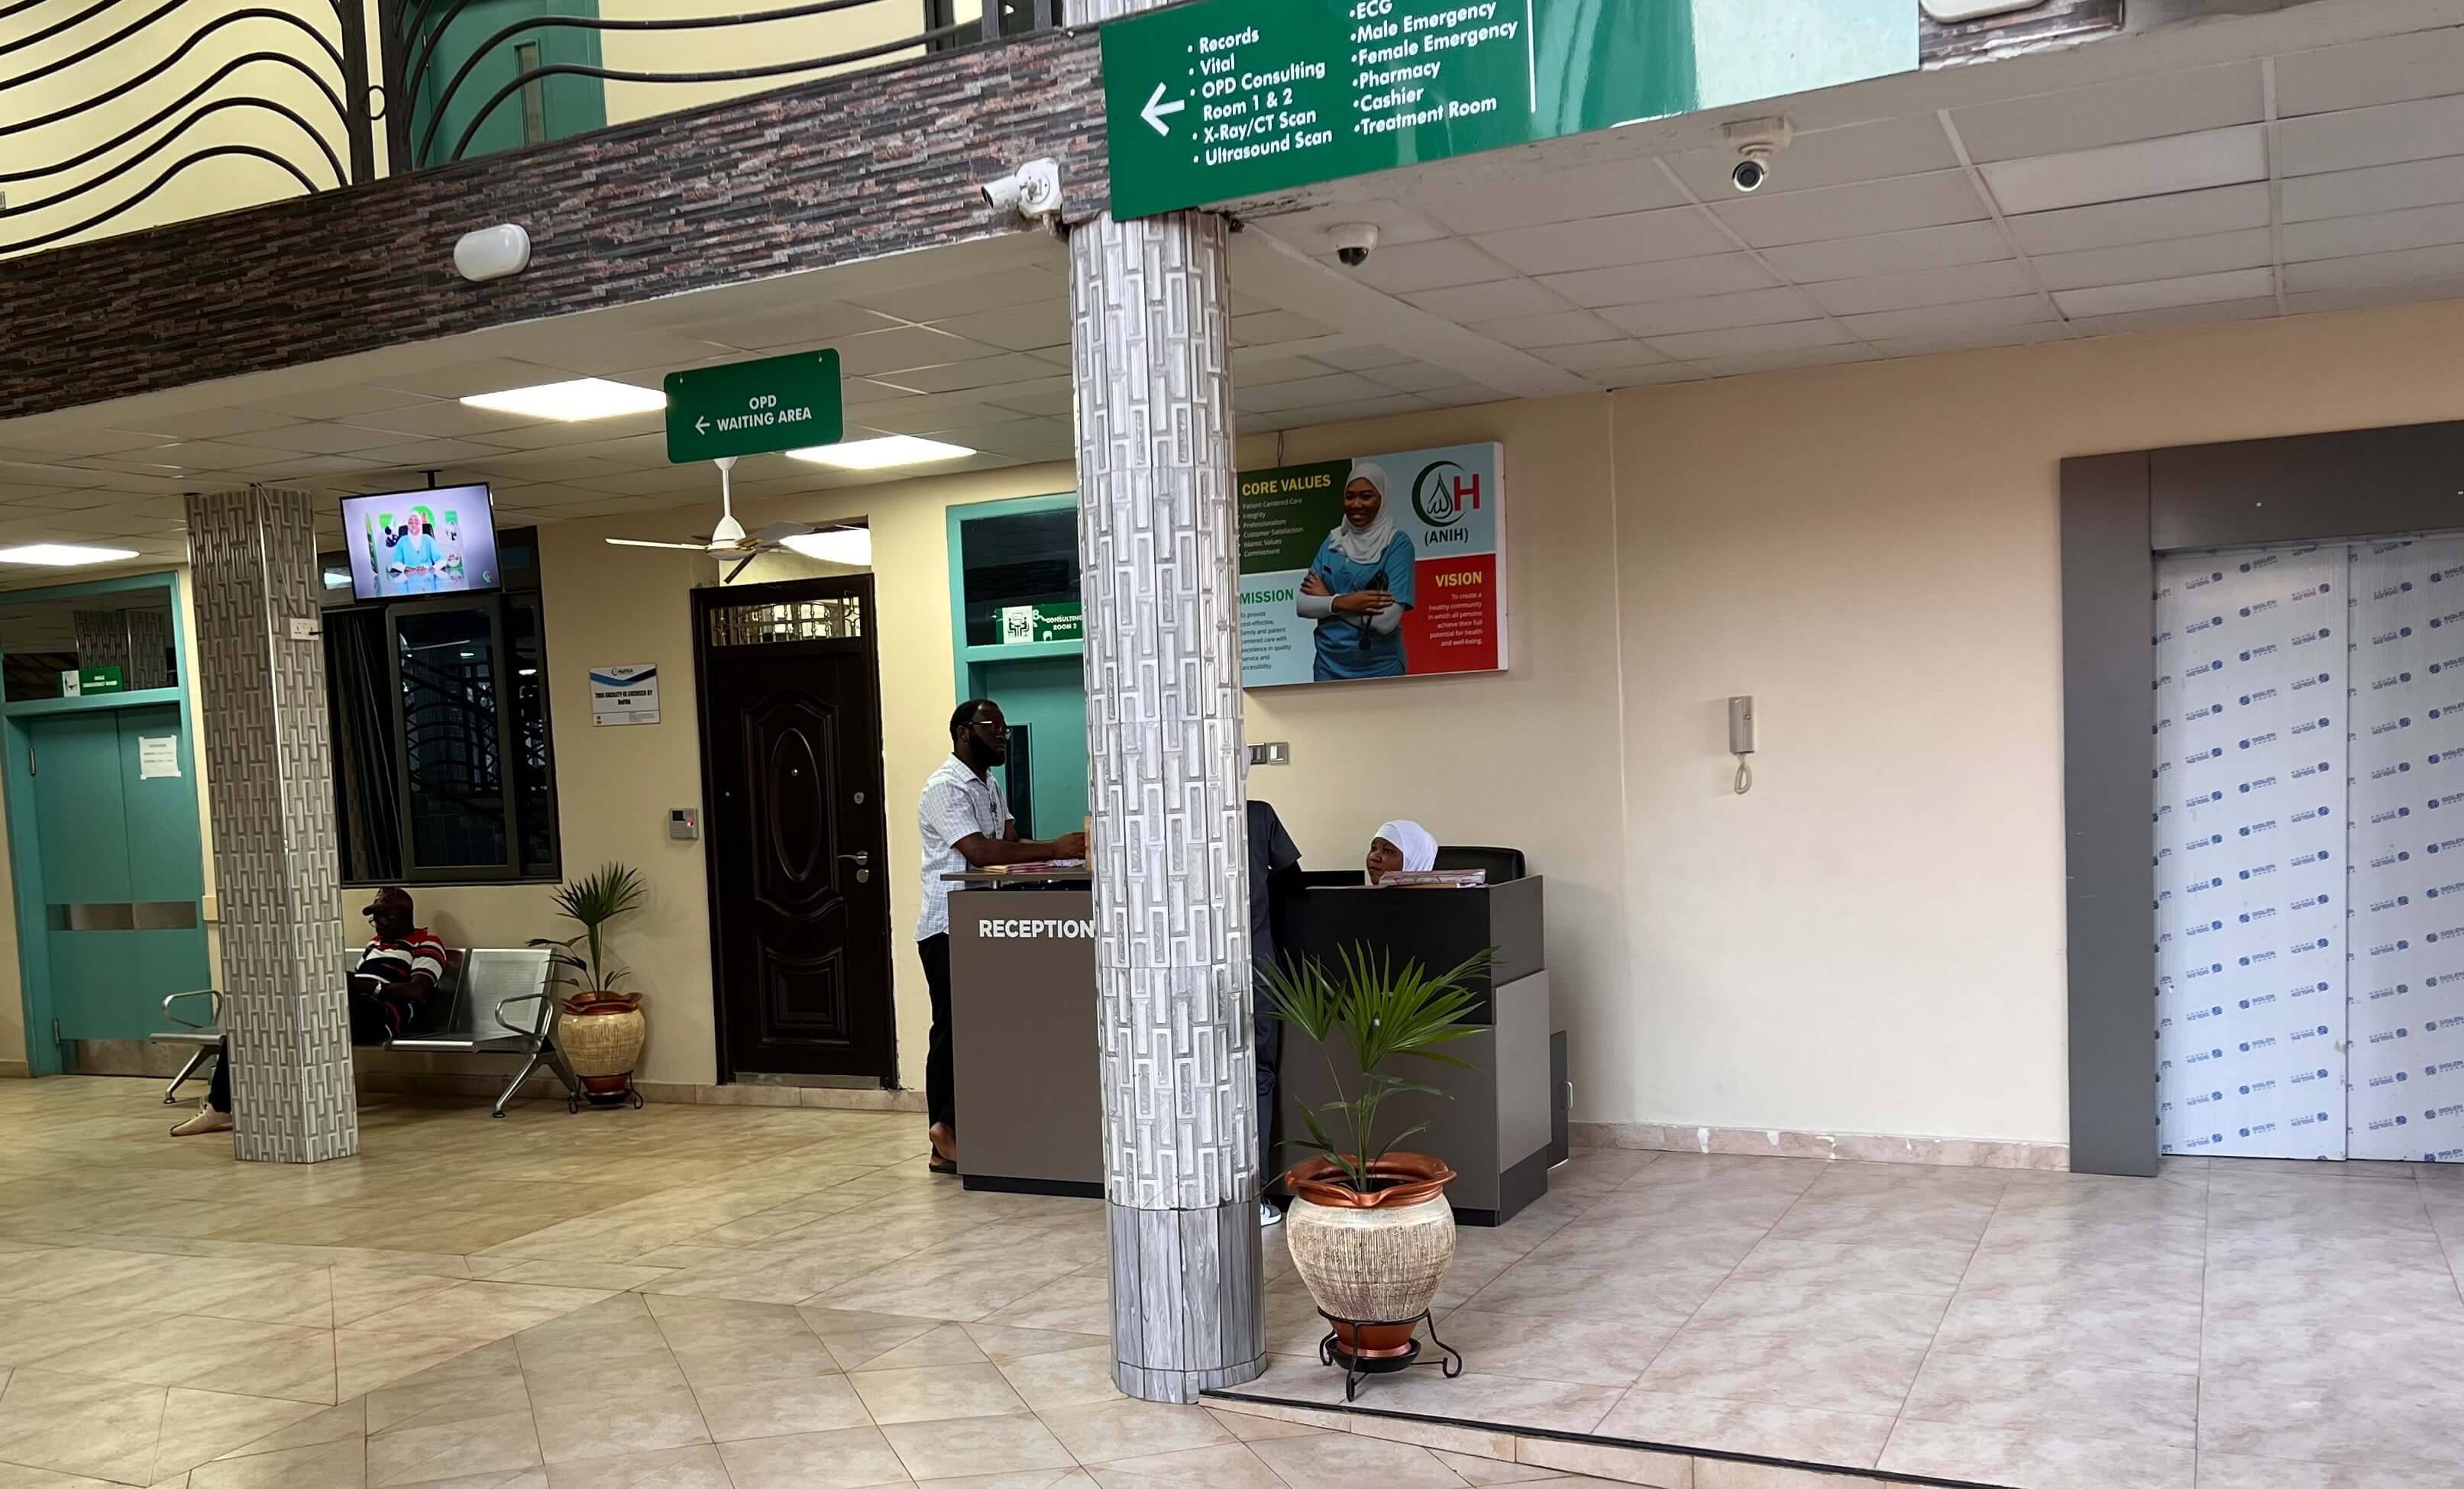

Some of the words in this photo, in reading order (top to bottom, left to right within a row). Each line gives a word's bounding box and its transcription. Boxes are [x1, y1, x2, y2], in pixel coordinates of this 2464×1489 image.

[1356, 0, 1392, 19] ECG
[1358, 21, 1398, 43] Male
[1404, 2, 1496, 33] Emergency
[1199, 26, 1259, 53] Records
[1359, 39, 1418, 66] Female
[1424, 21, 1518, 52] Emergency
[1200, 53, 1235, 76] Vital
[1360, 61, 1441, 89] Pharmacy
[1202, 76, 1236, 98] OPD
[1241, 61, 1325, 90] Consulting
[1204, 101, 1247, 121] Room
[1253, 94, 1259, 111] 1
[1266, 91, 1278, 108] &
[1282, 88, 1293, 105] 2
[1360, 86, 1424, 111] Cashier
[1204, 114, 1275, 144] X-Ray/CT
[1279, 110, 1317, 129] Scan
[1360, 105, 1444, 135] Treatment
[1449, 97, 1497, 118] Room
[1205, 133, 1290, 166] Ultrasound
[1295, 130, 1333, 149] Scan
[749, 394, 777, 410] OPD
[716, 412, 774, 431] WAITING
[778, 406, 813, 424] AREA
[1242, 480, 1278, 496] CORE
[1281, 474, 1331, 492] VALUES
[1424, 528, 1469, 547] (ANIH)
[1436, 571, 1482, 587] VISION
[1240, 588, 1294, 605] MISSION
[979, 919, 1095, 938] RECEPTION
